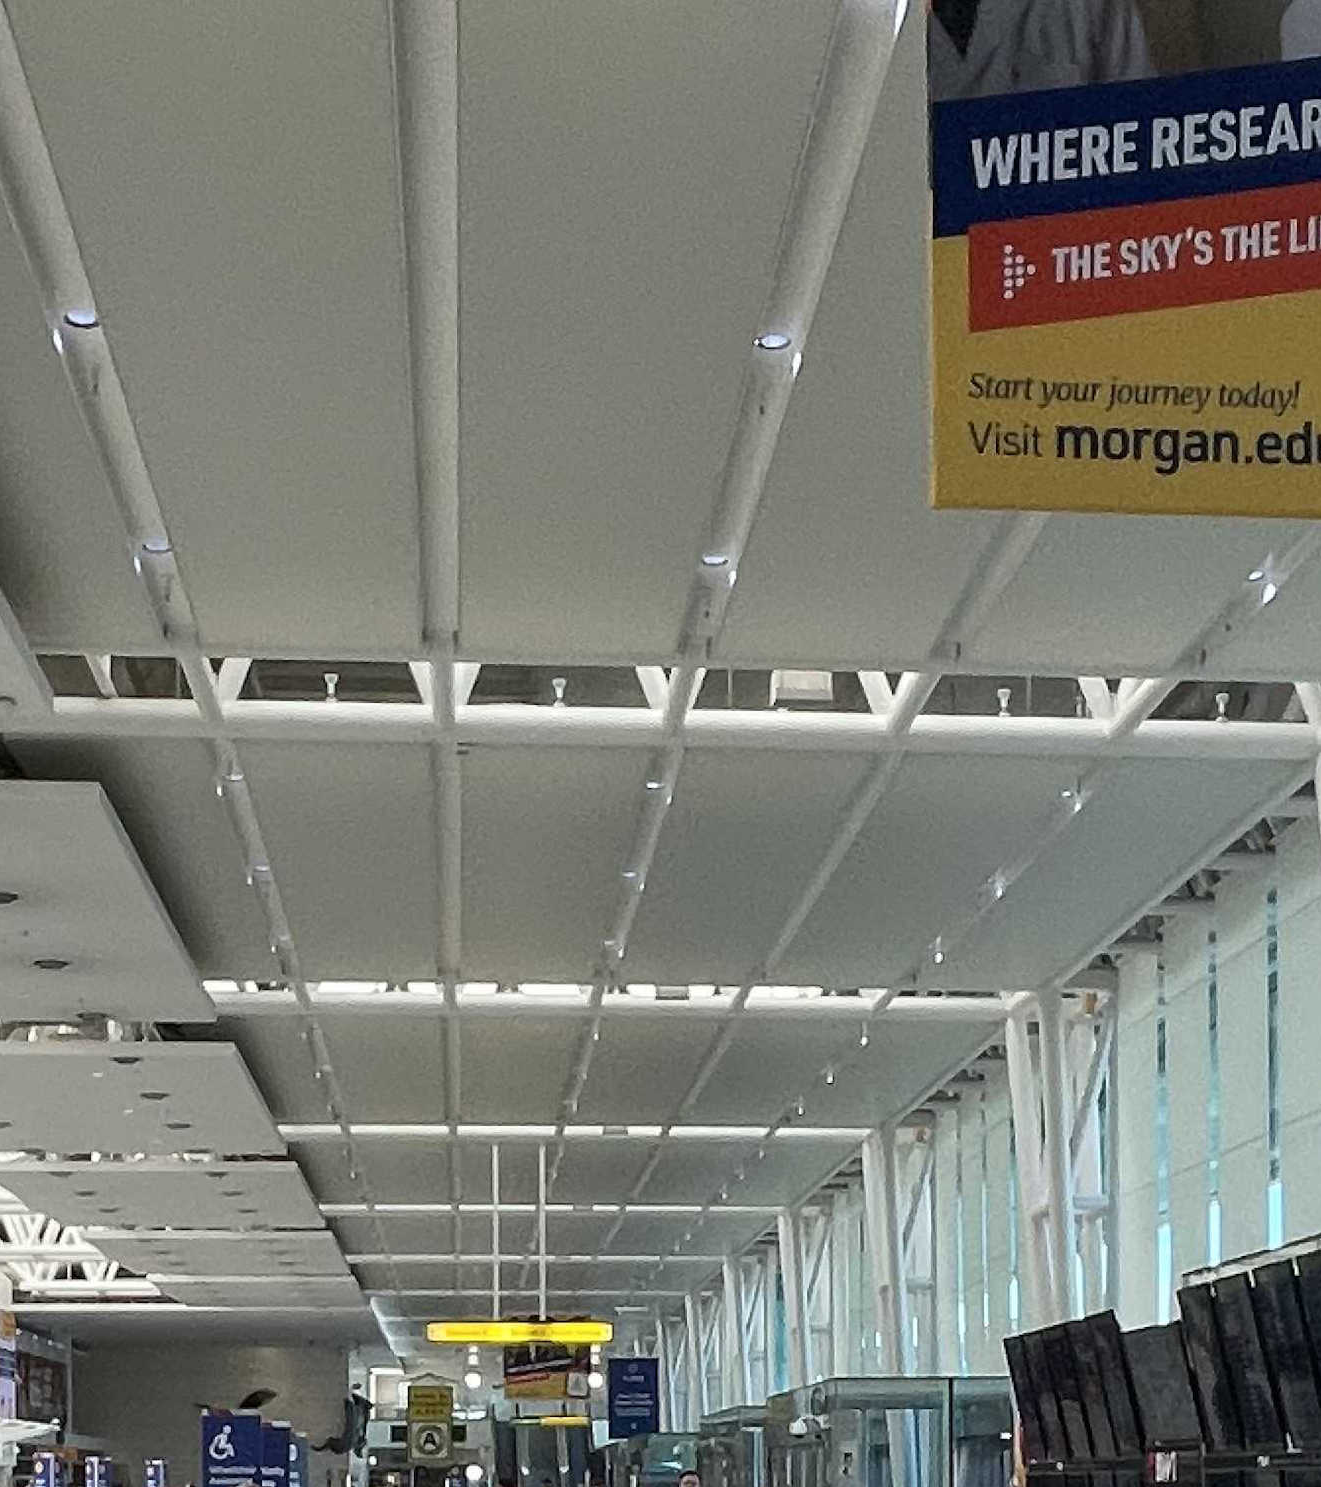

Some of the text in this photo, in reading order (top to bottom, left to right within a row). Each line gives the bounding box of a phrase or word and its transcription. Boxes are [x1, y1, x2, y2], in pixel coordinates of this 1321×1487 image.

[971, 121, 1139, 190] WHERE
[1051, 242, 1113, 283] THE
[1119, 226, 1214, 277] SKY'S
[1220, 220, 1280, 262] THE
[967, 373, 1302, 416] Start your journey today!
[967, 421, 1043, 457] Visit
